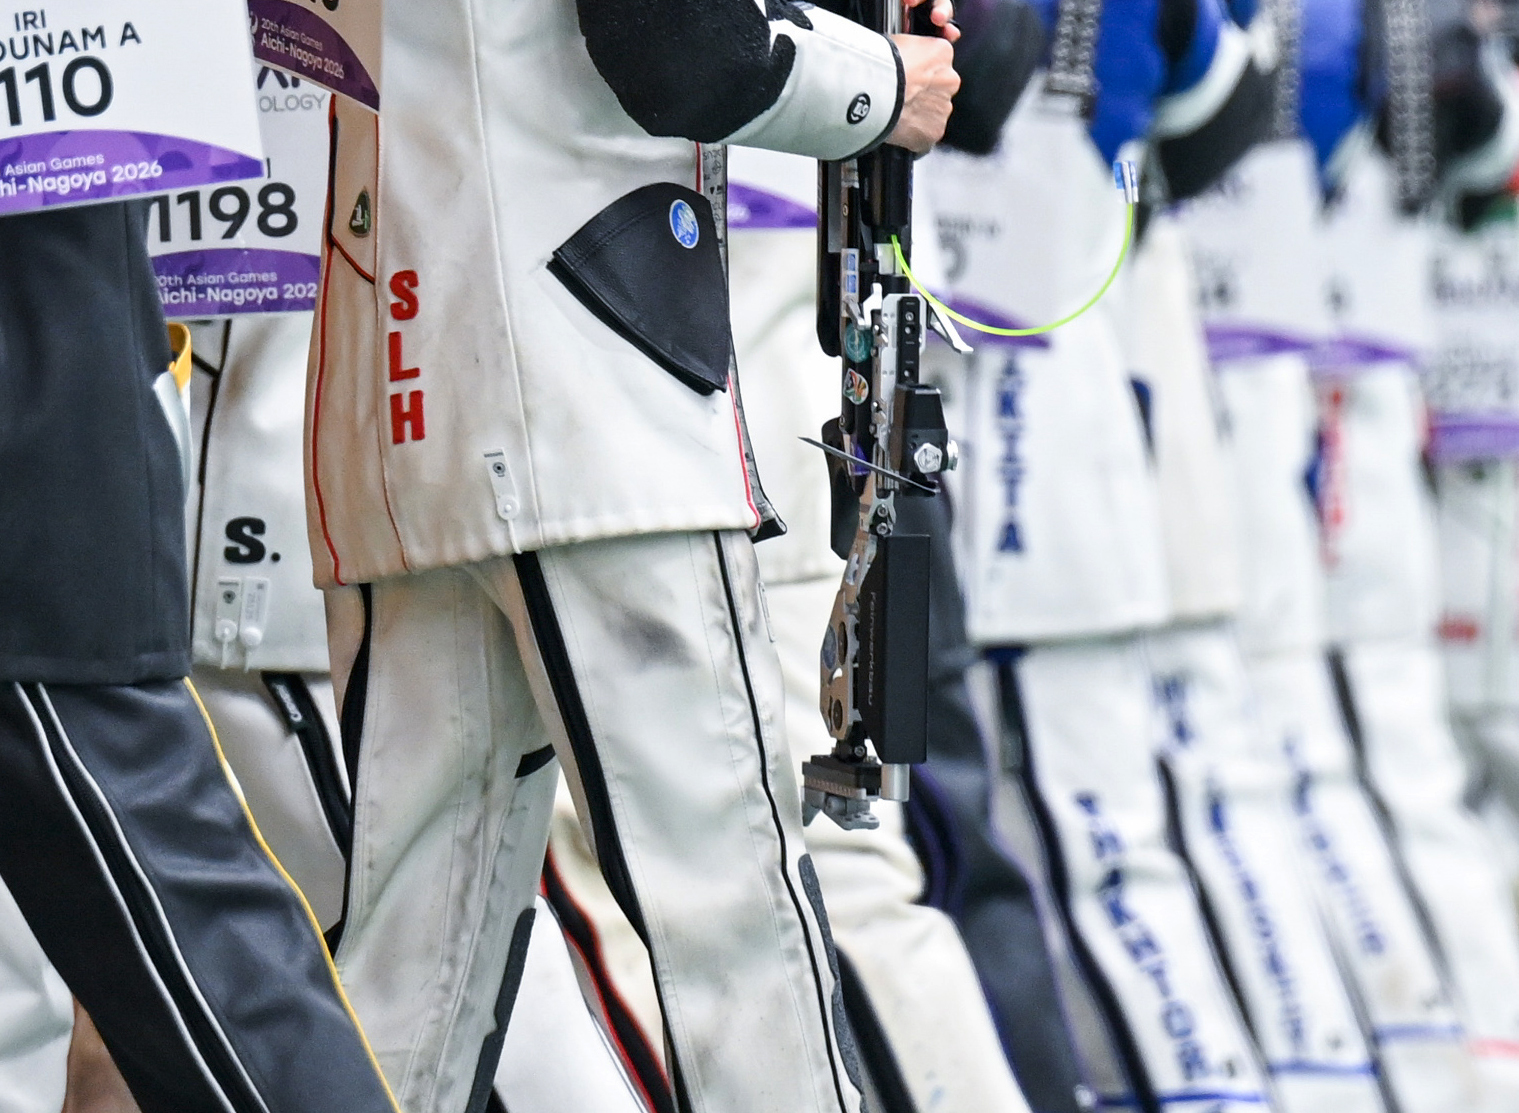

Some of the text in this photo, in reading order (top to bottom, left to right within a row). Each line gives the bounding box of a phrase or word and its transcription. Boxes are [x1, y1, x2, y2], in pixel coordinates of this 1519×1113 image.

[14, 8, 47, 32] IRI
[119, 21, 142, 47] A
[261, 32, 322, 71] Aichi-Nagoya
[323, 57, 344, 79] 2026
[259, 94, 326, 113] OLOGY
[5, 159, 47, 177] Asian
[50, 152, 105, 172] Games
[112, 159, 164, 185] 2026
[152, 182, 298, 242] 1198
[187, 272, 225, 285] Asian
[228, 271, 277, 284] Games
[283, 282, 317, 299] 202
